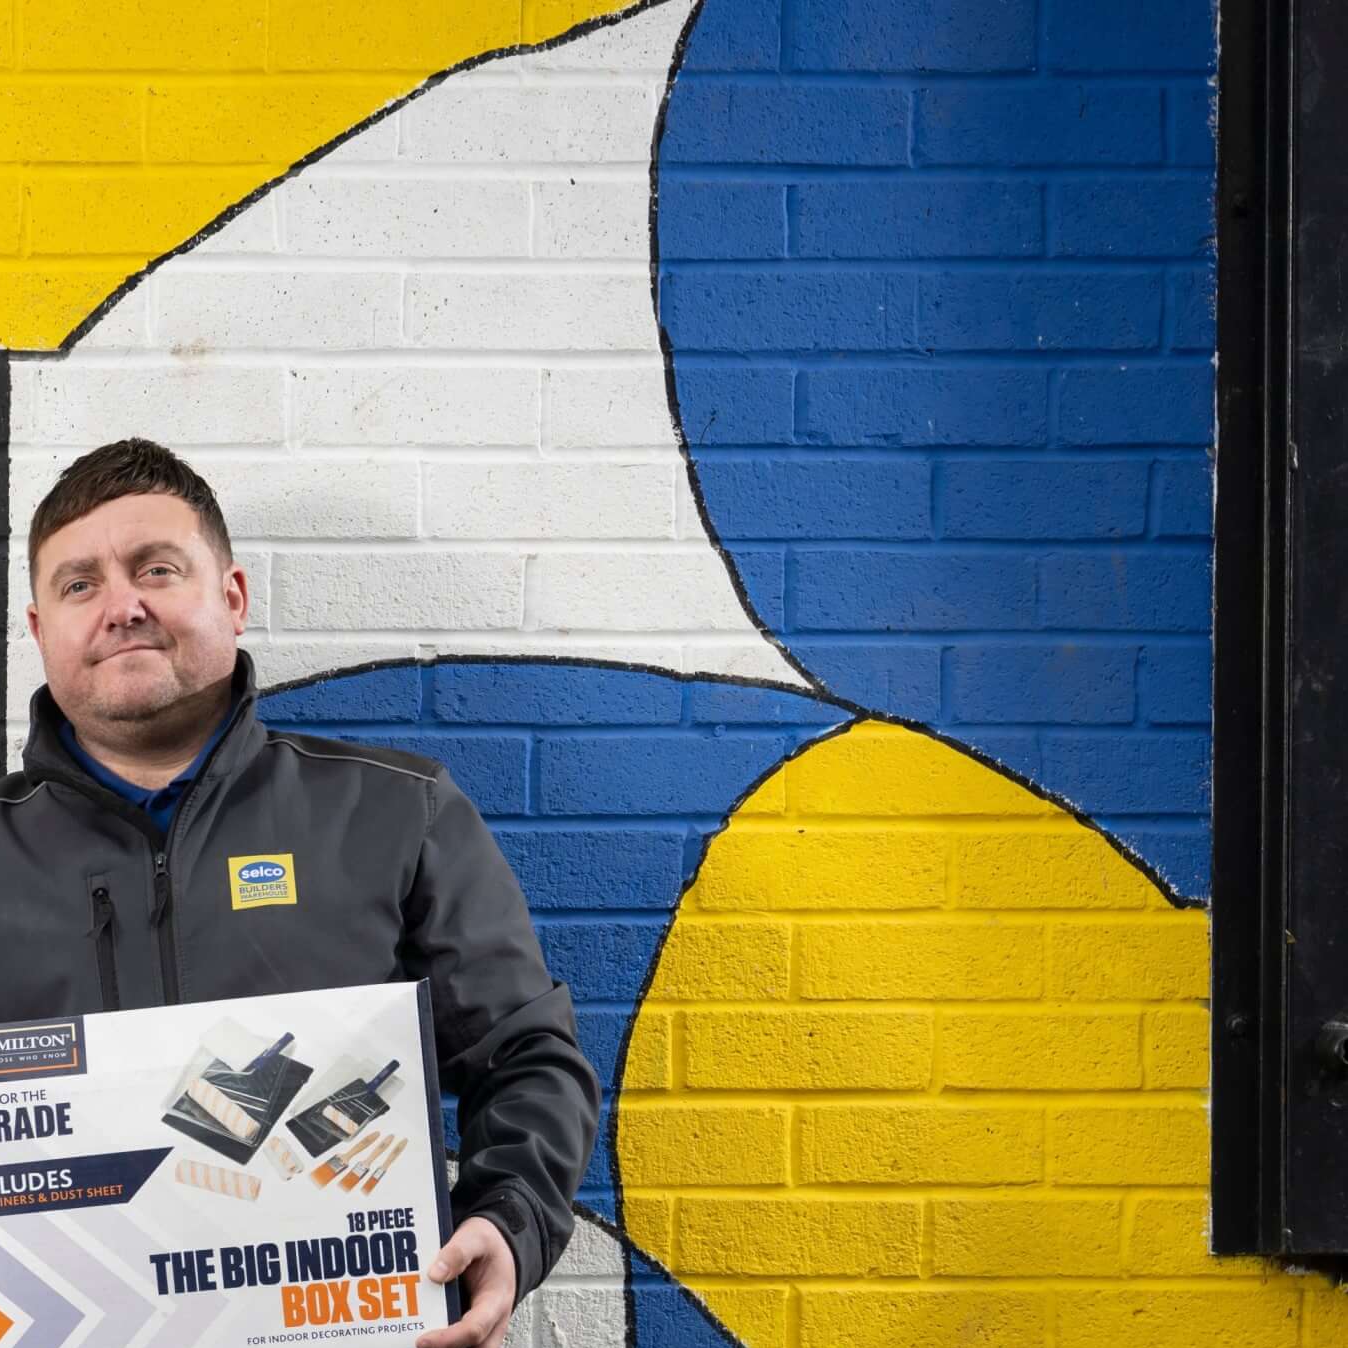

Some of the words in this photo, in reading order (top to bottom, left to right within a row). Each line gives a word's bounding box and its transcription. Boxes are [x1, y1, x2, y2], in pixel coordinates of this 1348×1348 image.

[241, 866, 284, 879] selco
[239, 884, 288, 894] BUILDERS
[43, 1052, 67, 1060] KNOW
[22, 1090, 47, 1102] THE
[38, 1192, 48, 1203] &
[51, 1188, 83, 1202] DUST
[87, 1184, 123, 1198] SHEET
[346, 1212, 365, 1232] 18
[368, 1207, 415, 1231] PIECE
[150, 1249, 217, 1295] THE
[220, 1243, 281, 1289] BIG
[285, 1230, 419, 1283] INDOOR
[281, 1281, 354, 1328] BOX
[357, 1274, 420, 1321] SET
[247, 1337, 266, 1345] FOR
[269, 1333, 309, 1344] INDOOR
[311, 1327, 376, 1340] DECORATING
[378, 1322, 425, 1335] PROJECTS
